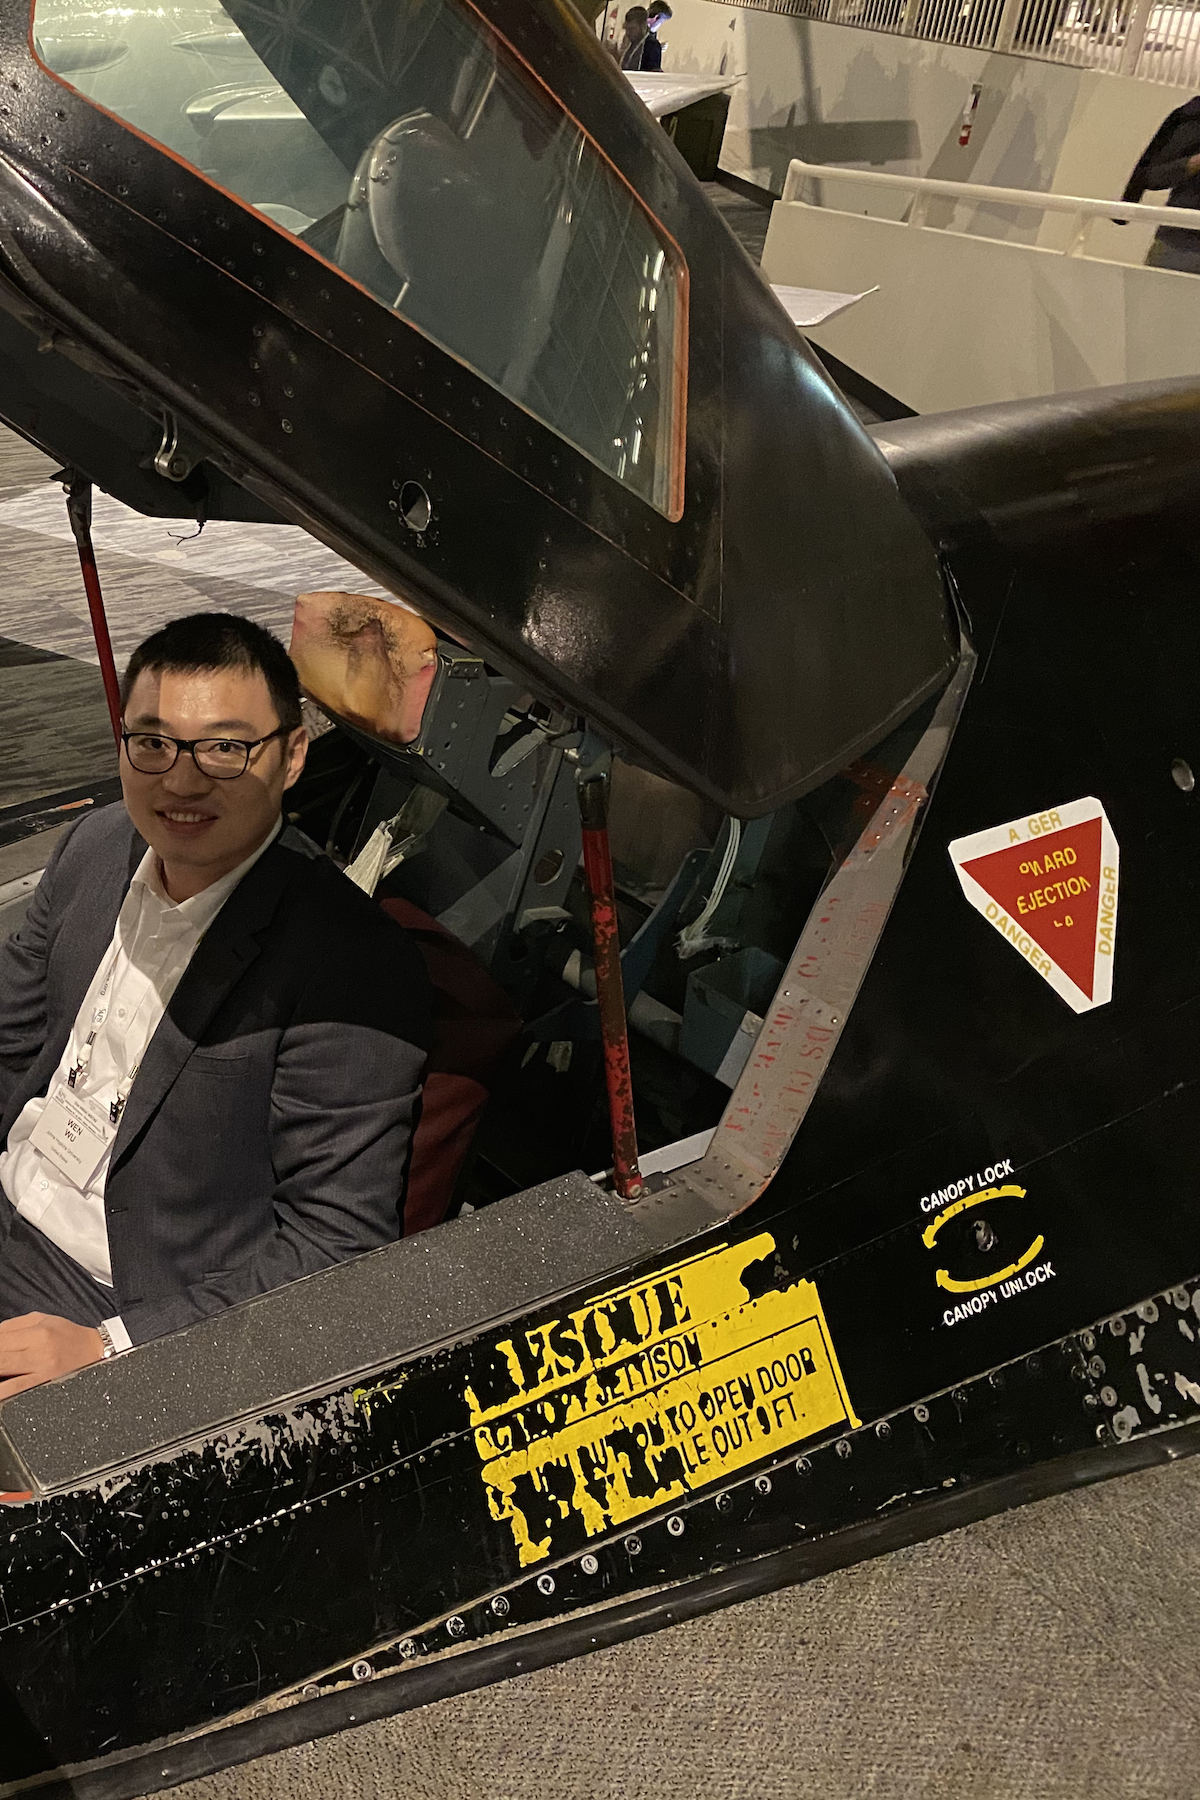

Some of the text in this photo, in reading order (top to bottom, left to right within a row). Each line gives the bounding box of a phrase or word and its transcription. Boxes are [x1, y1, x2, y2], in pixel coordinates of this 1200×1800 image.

[1098, 865, 1116, 957] DANGER
[984, 902, 1052, 978] DANGER
[64, 1128, 77, 1143] WU
[67, 1117, 84, 1136] WEN
[920, 1158, 1015, 1213] CANOPY LOCK
[943, 1261, 1057, 1327] CANOPY UNLOCK
[699, 1372, 757, 1422] OPEN
[710, 1411, 754, 1459] OUT
